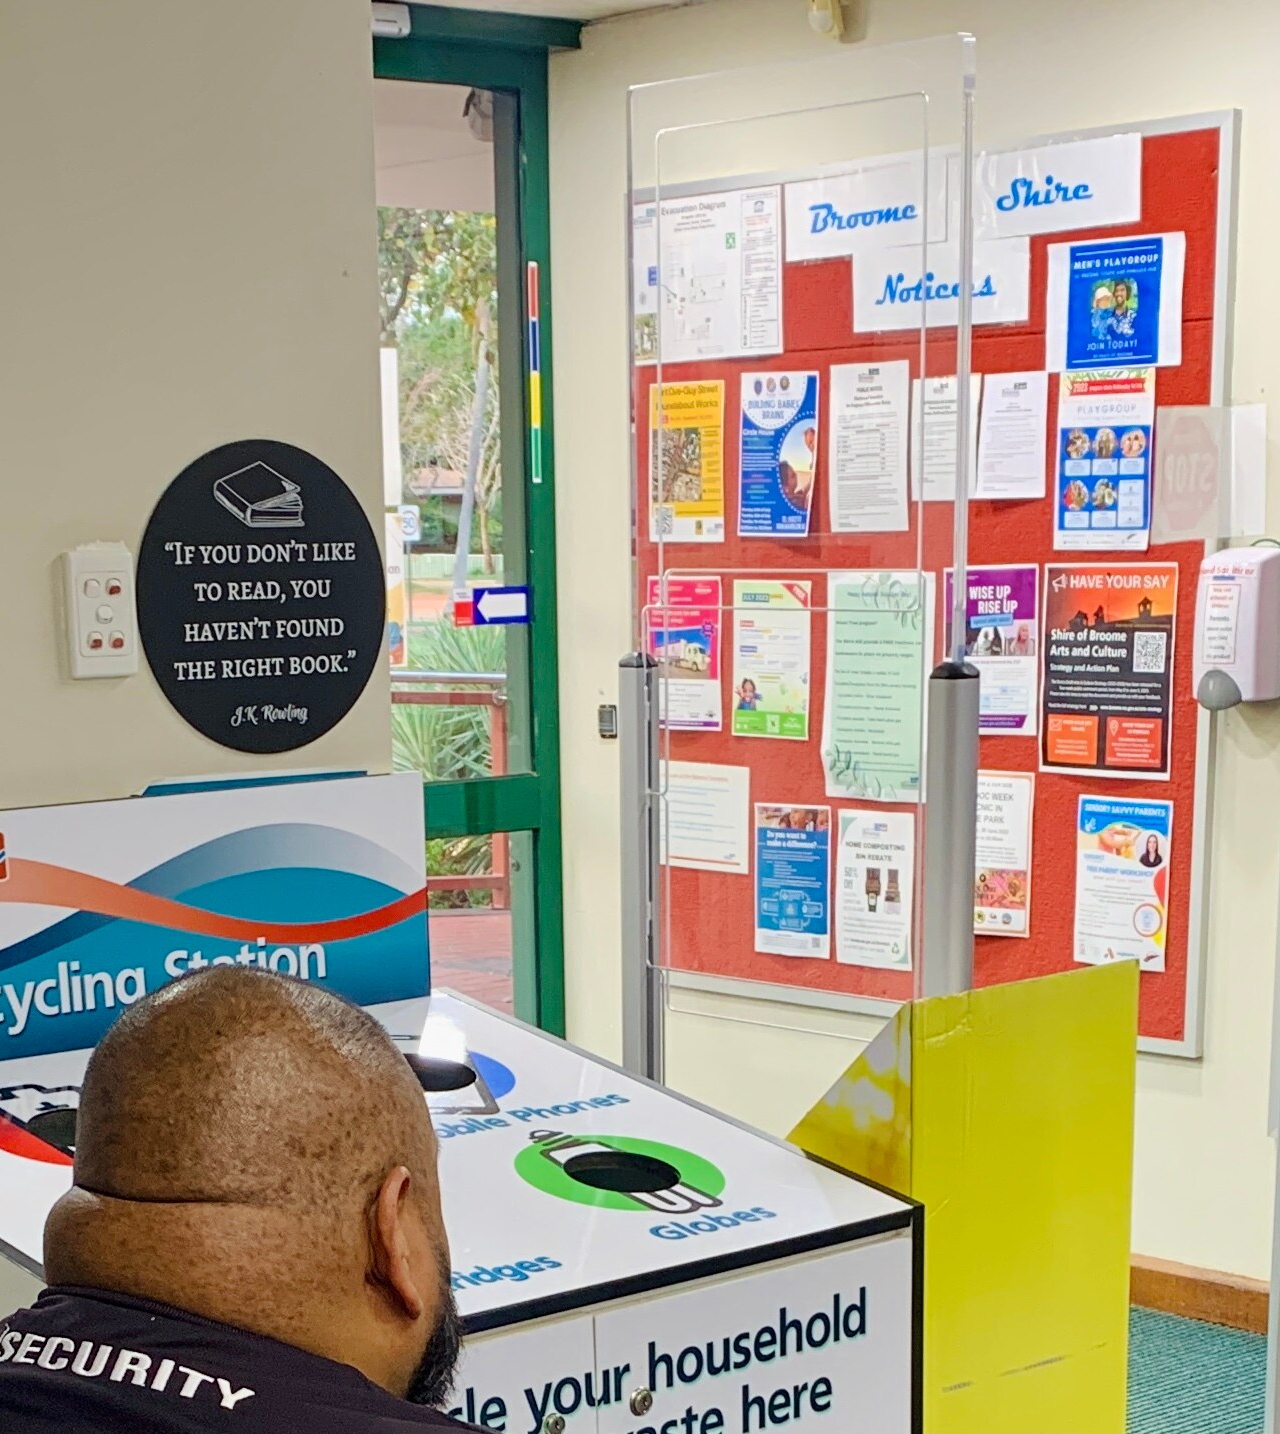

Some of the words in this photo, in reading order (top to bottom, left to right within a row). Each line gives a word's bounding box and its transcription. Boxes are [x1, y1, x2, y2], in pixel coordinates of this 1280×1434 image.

[808, 200, 919, 235] Broome
[994, 173, 1094, 213] Shire
[1074, 259, 1101, 270] MEN'S
[1104, 254, 1159, 267] PLAYGROUP
[874, 273, 997, 307] Notices
[1087, 341, 1104, 351] JOIN
[1108, 339, 1138, 349] TODAY!
[200, 545, 241, 563] YOU
[247, 540, 307, 563] DON'T
[312, 542, 355, 562] LIKE
[194, 582, 221, 602] TO
[227, 581, 286, 604] READ,
[290, 580, 331, 598] YOU
[969, 586, 995, 600] WISE
[996, 585, 1011, 599] UP
[1070, 576, 1105, 589] HAVE
[1106, 575, 1142, 589] YOUR
[1143, 574, 1170, 589] SAY
[978, 601, 1001, 614] RISE
[1003, 599, 1018, 613] UP
[184, 617, 271, 643] HAVEN'T
[276, 618, 344, 639] FOUND
[1050, 628, 1075, 641] Shire
[1077, 629, 1088, 641] of
[1089, 630, 1127, 642] Broome
[1050, 645, 1070, 657] Arts
[1072, 645, 1090, 658] and
[1092, 646, 1127, 658] Culture
[174, 661, 215, 680] THE
[221, 657, 284, 678] RIGHT
[230, 704, 259, 726] J.K.
[261, 703, 308, 724] Rowling
[992, 793, 1013, 801] WEEK
[1135, 807, 1166, 817] PARENTS
[164, 936, 329, 983] Sttion
[438, 1113, 510, 1139] obile
[508, 1090, 631, 1127] Phones
[649, 1204, 778, 1241] Globes
[647, 1286, 868, 1394] household
[742, 1376, 833, 1434] here
